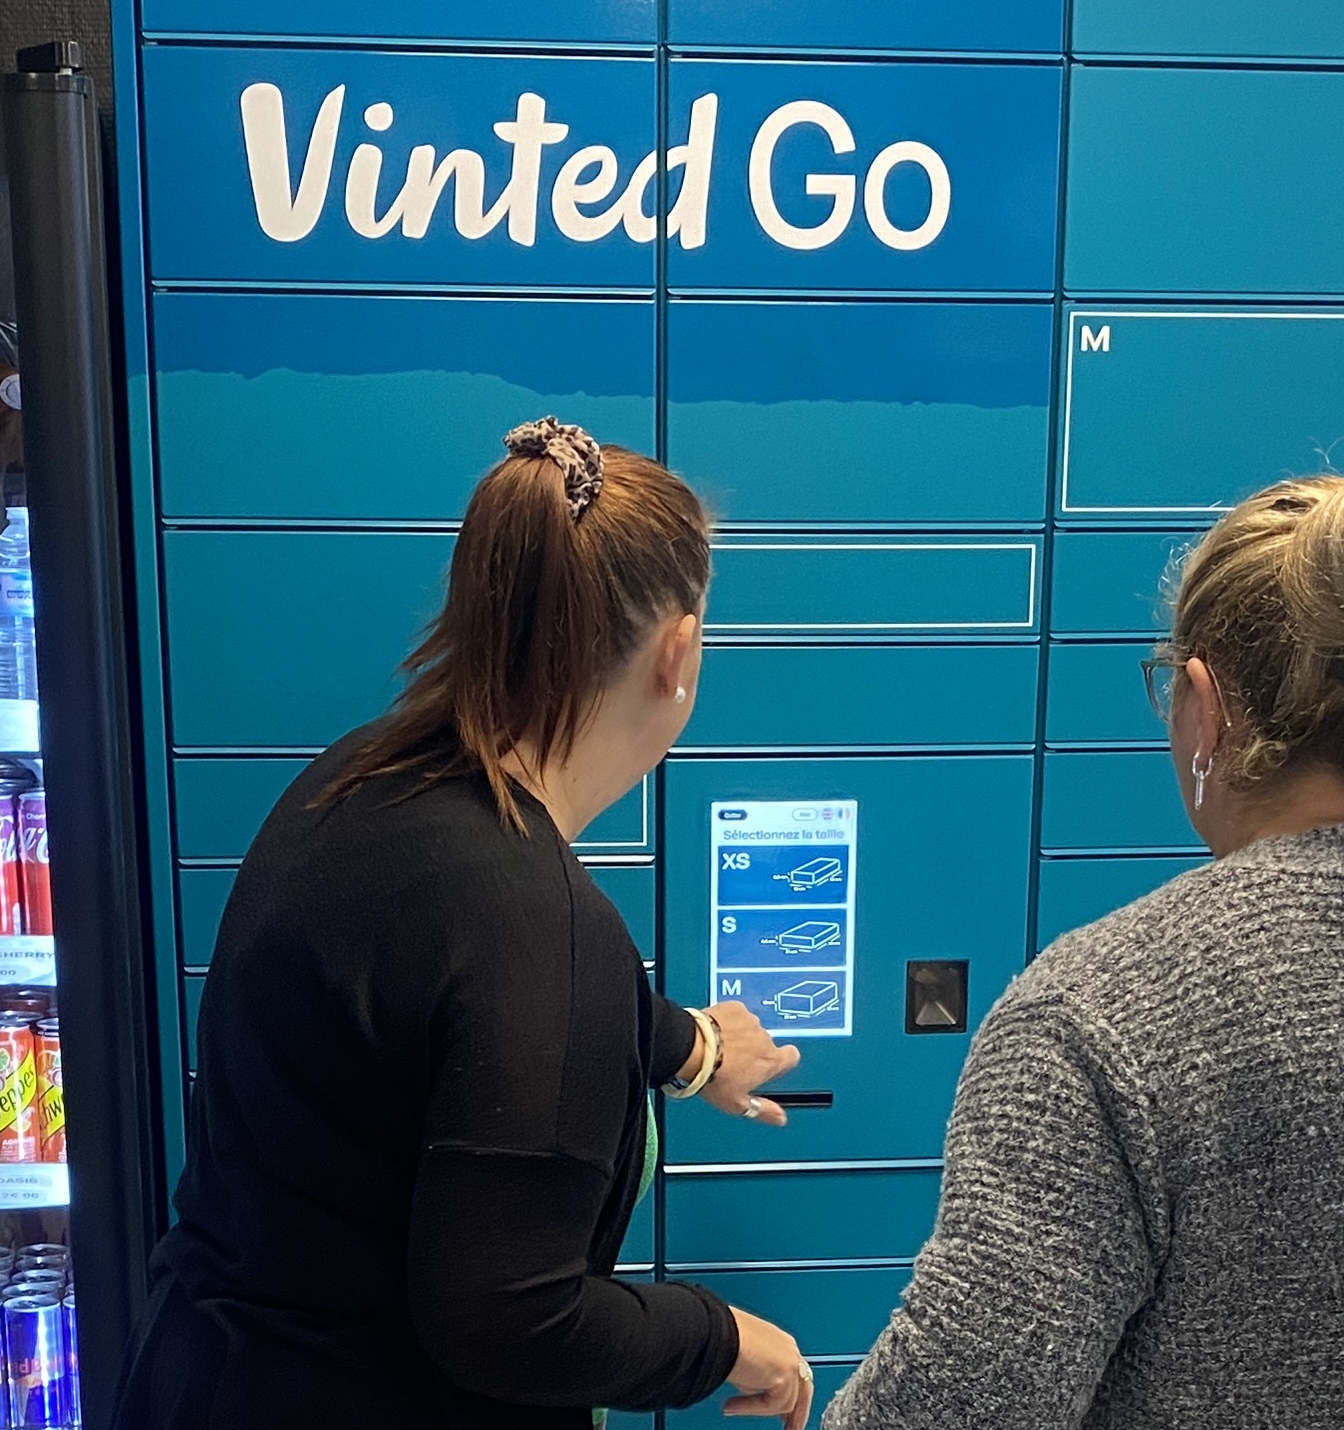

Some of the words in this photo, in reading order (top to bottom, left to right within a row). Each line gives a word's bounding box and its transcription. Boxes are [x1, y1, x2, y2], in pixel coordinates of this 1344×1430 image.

[240, 82, 718, 250] Vinted
[748, 100, 951, 251] Go
[1080, 325, 1110, 352] M
[723, 829, 800, 841] Sélectionnez
[802, 829, 813, 840] la
[816, 829, 845, 840] taille
[722, 853, 751, 870] XS
[721, 916, 737, 934] S
[721, 980, 742, 995] M
